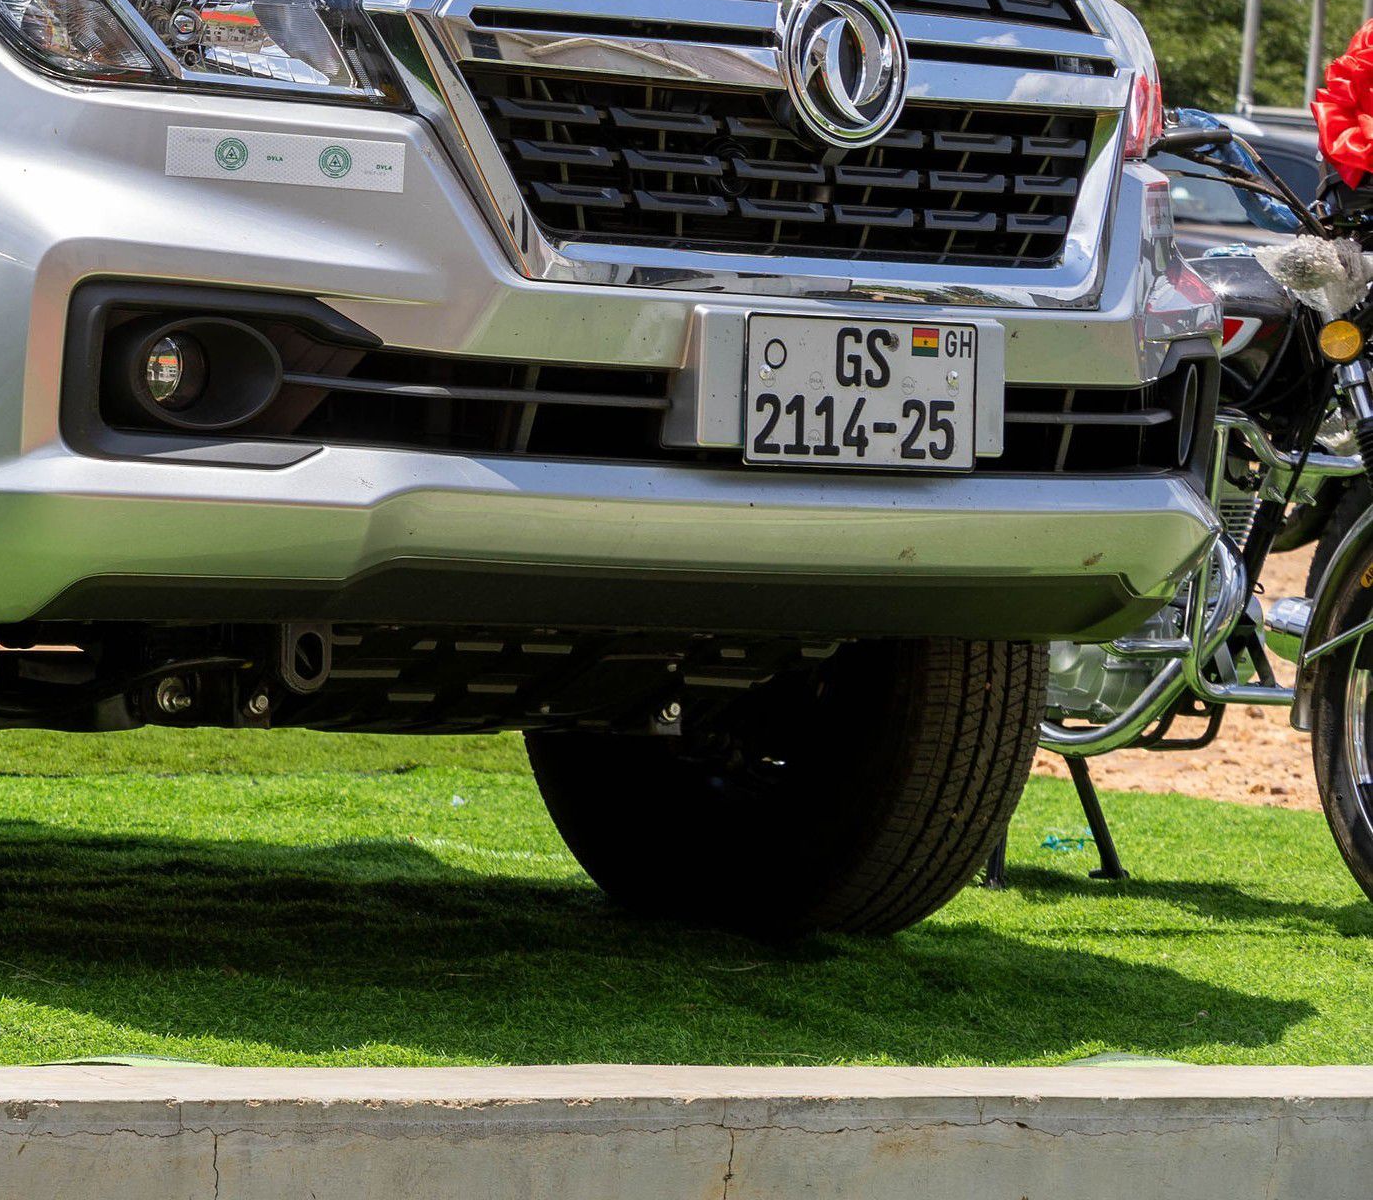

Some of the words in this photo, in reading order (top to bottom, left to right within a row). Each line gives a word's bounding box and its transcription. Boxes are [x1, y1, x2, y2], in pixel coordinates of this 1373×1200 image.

[835, 327, 891, 389] GS
[945, 330, 972, 359] GH
[753, 393, 955, 461] 2114-25
